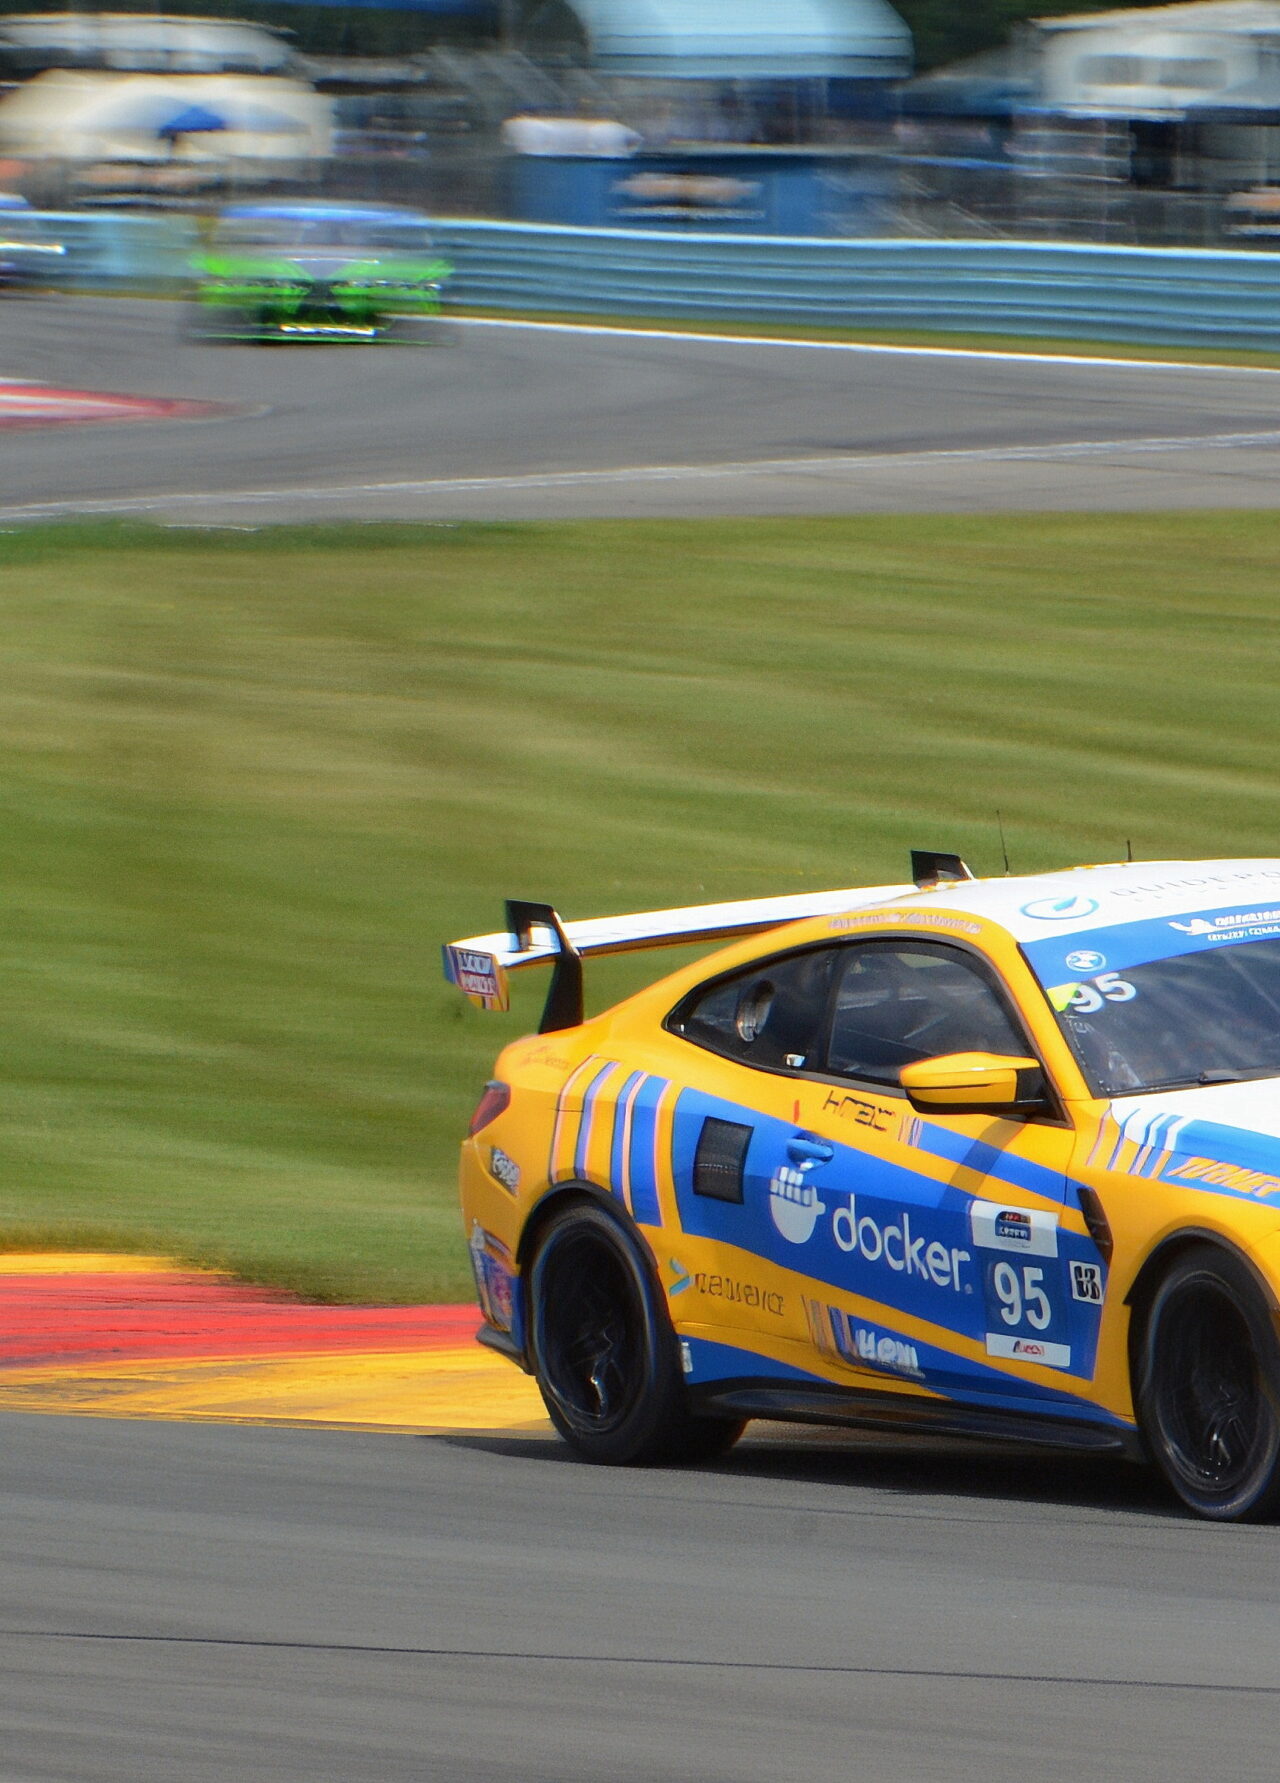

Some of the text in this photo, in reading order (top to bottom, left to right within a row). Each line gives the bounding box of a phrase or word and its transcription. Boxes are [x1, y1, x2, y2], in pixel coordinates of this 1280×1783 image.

[1070, 971, 1137, 1014] 95
[832, 1192, 971, 1292] docker
[994, 1261, 1052, 1331] 95
